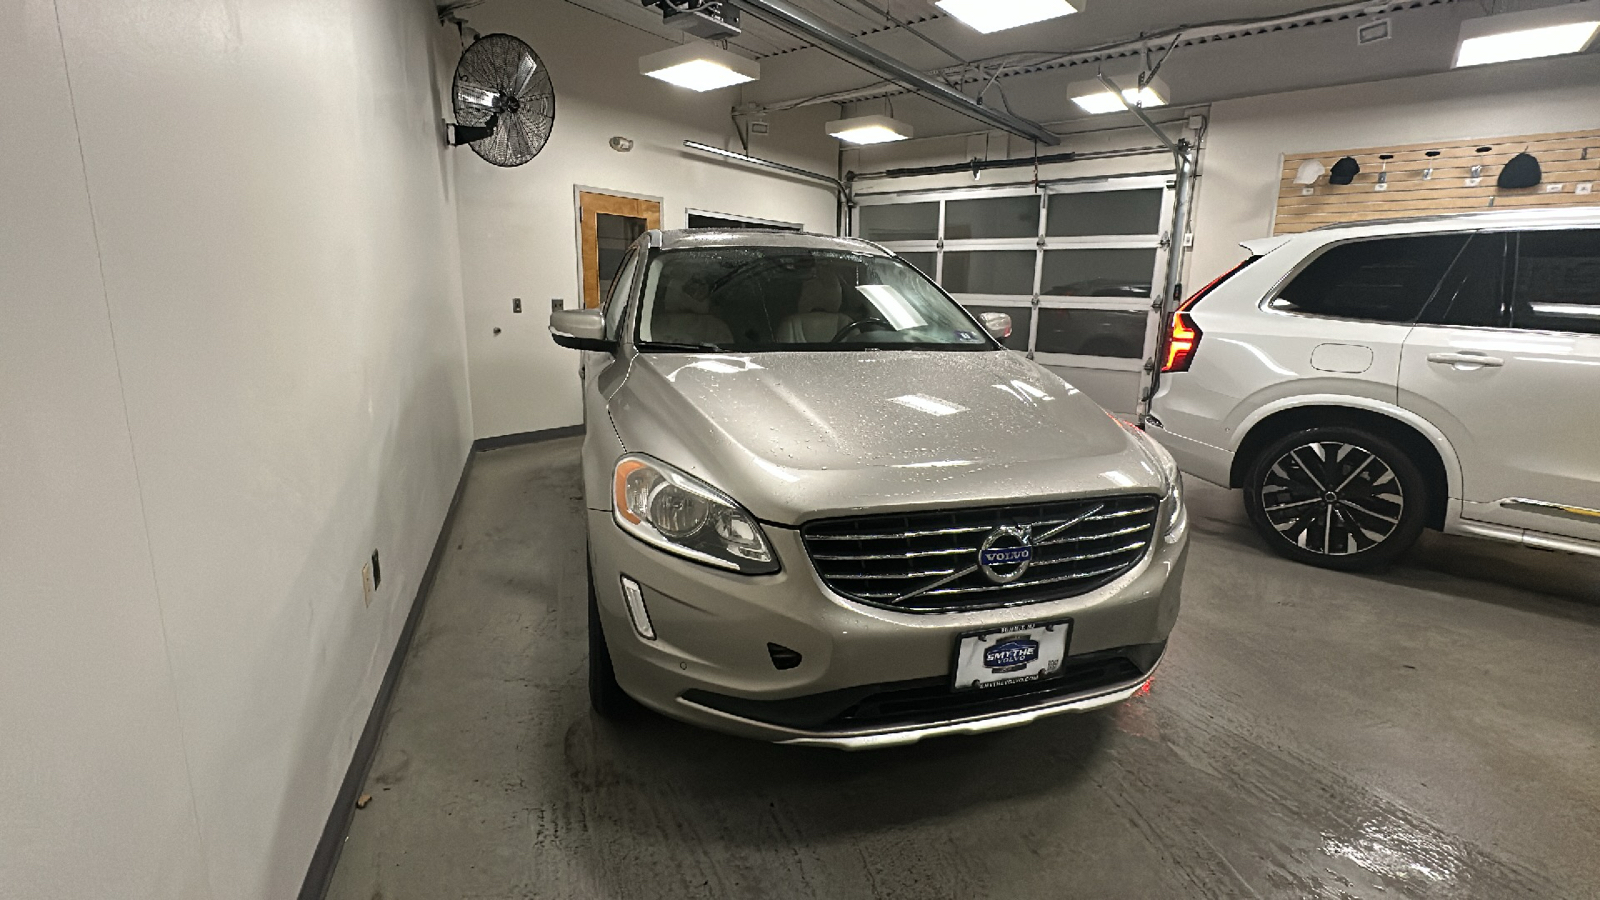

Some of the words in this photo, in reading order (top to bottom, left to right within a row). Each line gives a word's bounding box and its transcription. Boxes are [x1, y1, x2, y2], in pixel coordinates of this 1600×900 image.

[985, 549, 1029, 561] VOLVO
[986, 647, 1035, 661] SMYTHE
[997, 655, 1026, 664] VOLVO
